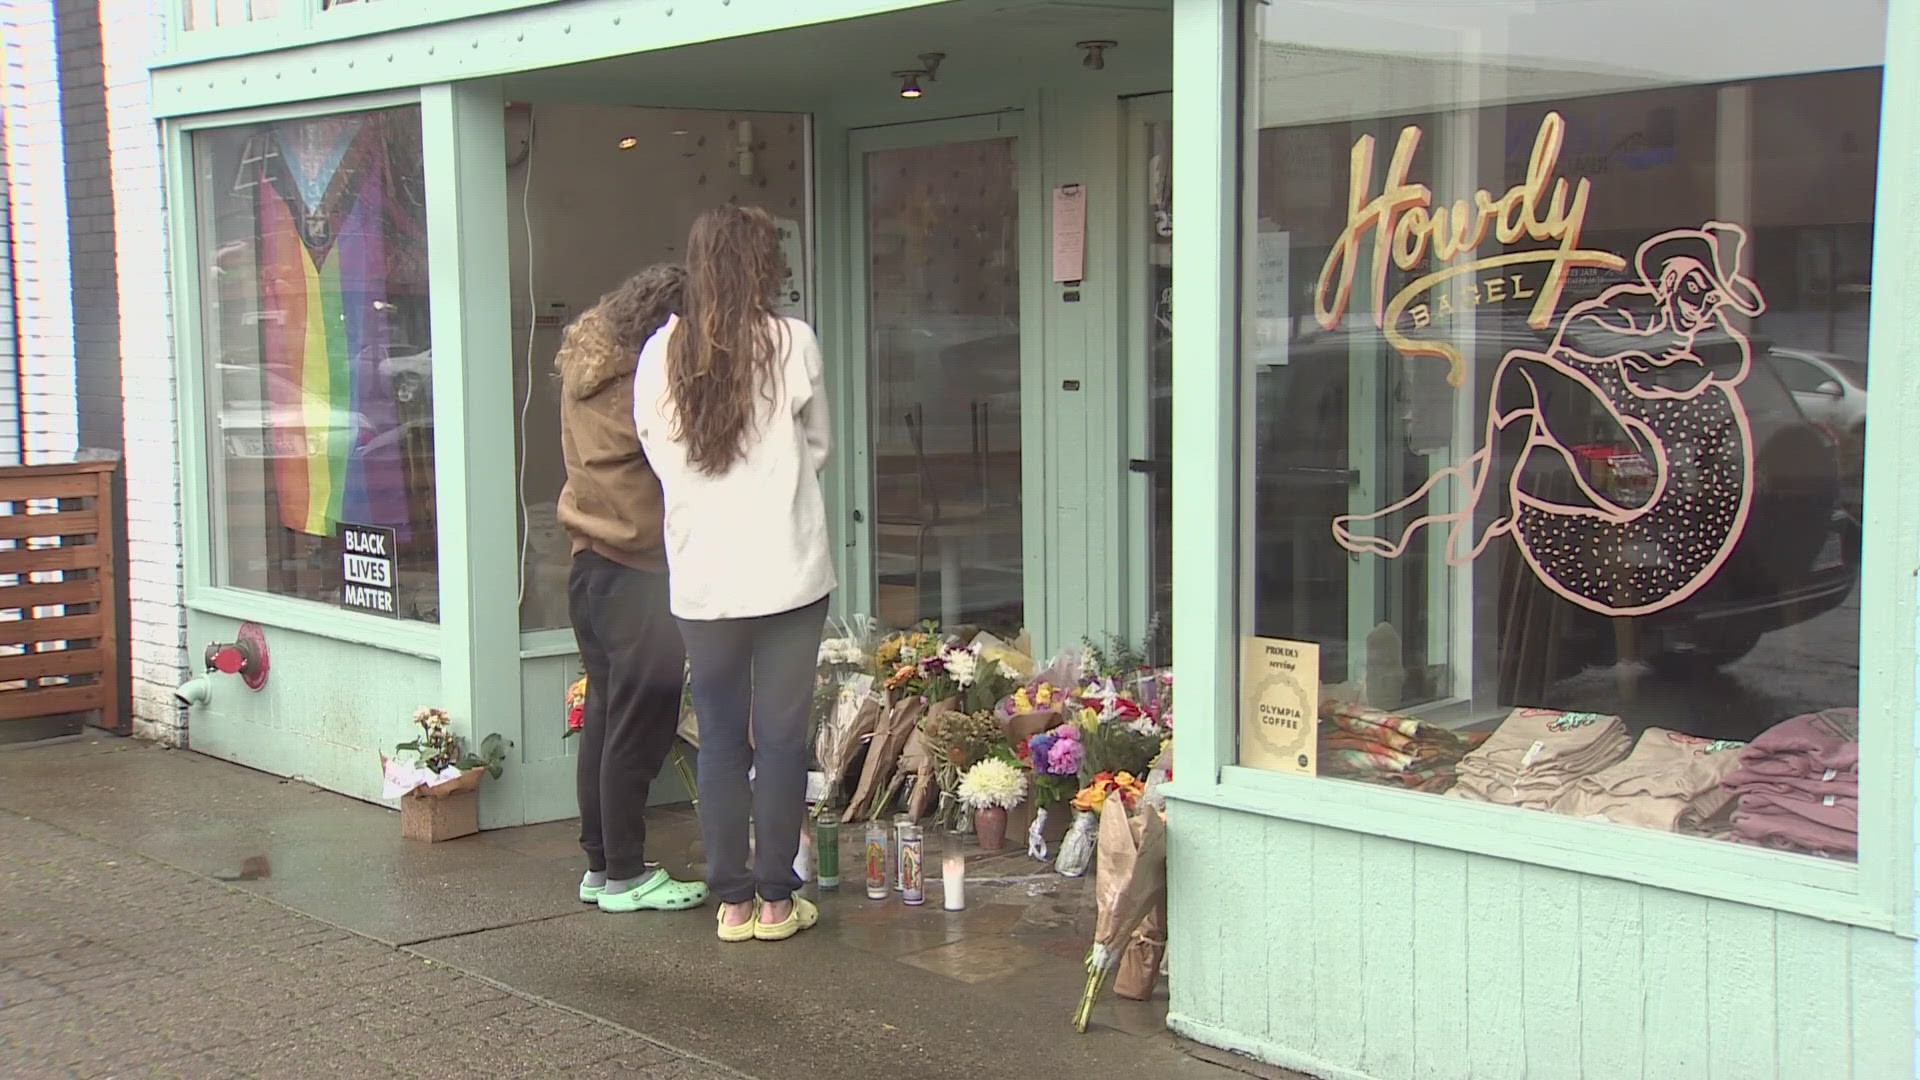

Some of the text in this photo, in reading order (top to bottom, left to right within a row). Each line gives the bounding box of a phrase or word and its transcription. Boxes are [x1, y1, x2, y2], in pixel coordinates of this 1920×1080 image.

[1314, 111, 1608, 330] Howdy
[1408, 274, 1535, 330] BAGEL
[344, 529, 386, 556] BLACK
[349, 558, 386, 583] LIVES
[344, 584, 393, 612] MATTER
[1265, 645, 1299, 658] PROUDLY
[1269, 660, 1296, 673] serving
[1260, 704, 1301, 719] OLYMPIA
[1262, 716, 1298, 730] COFFEE
